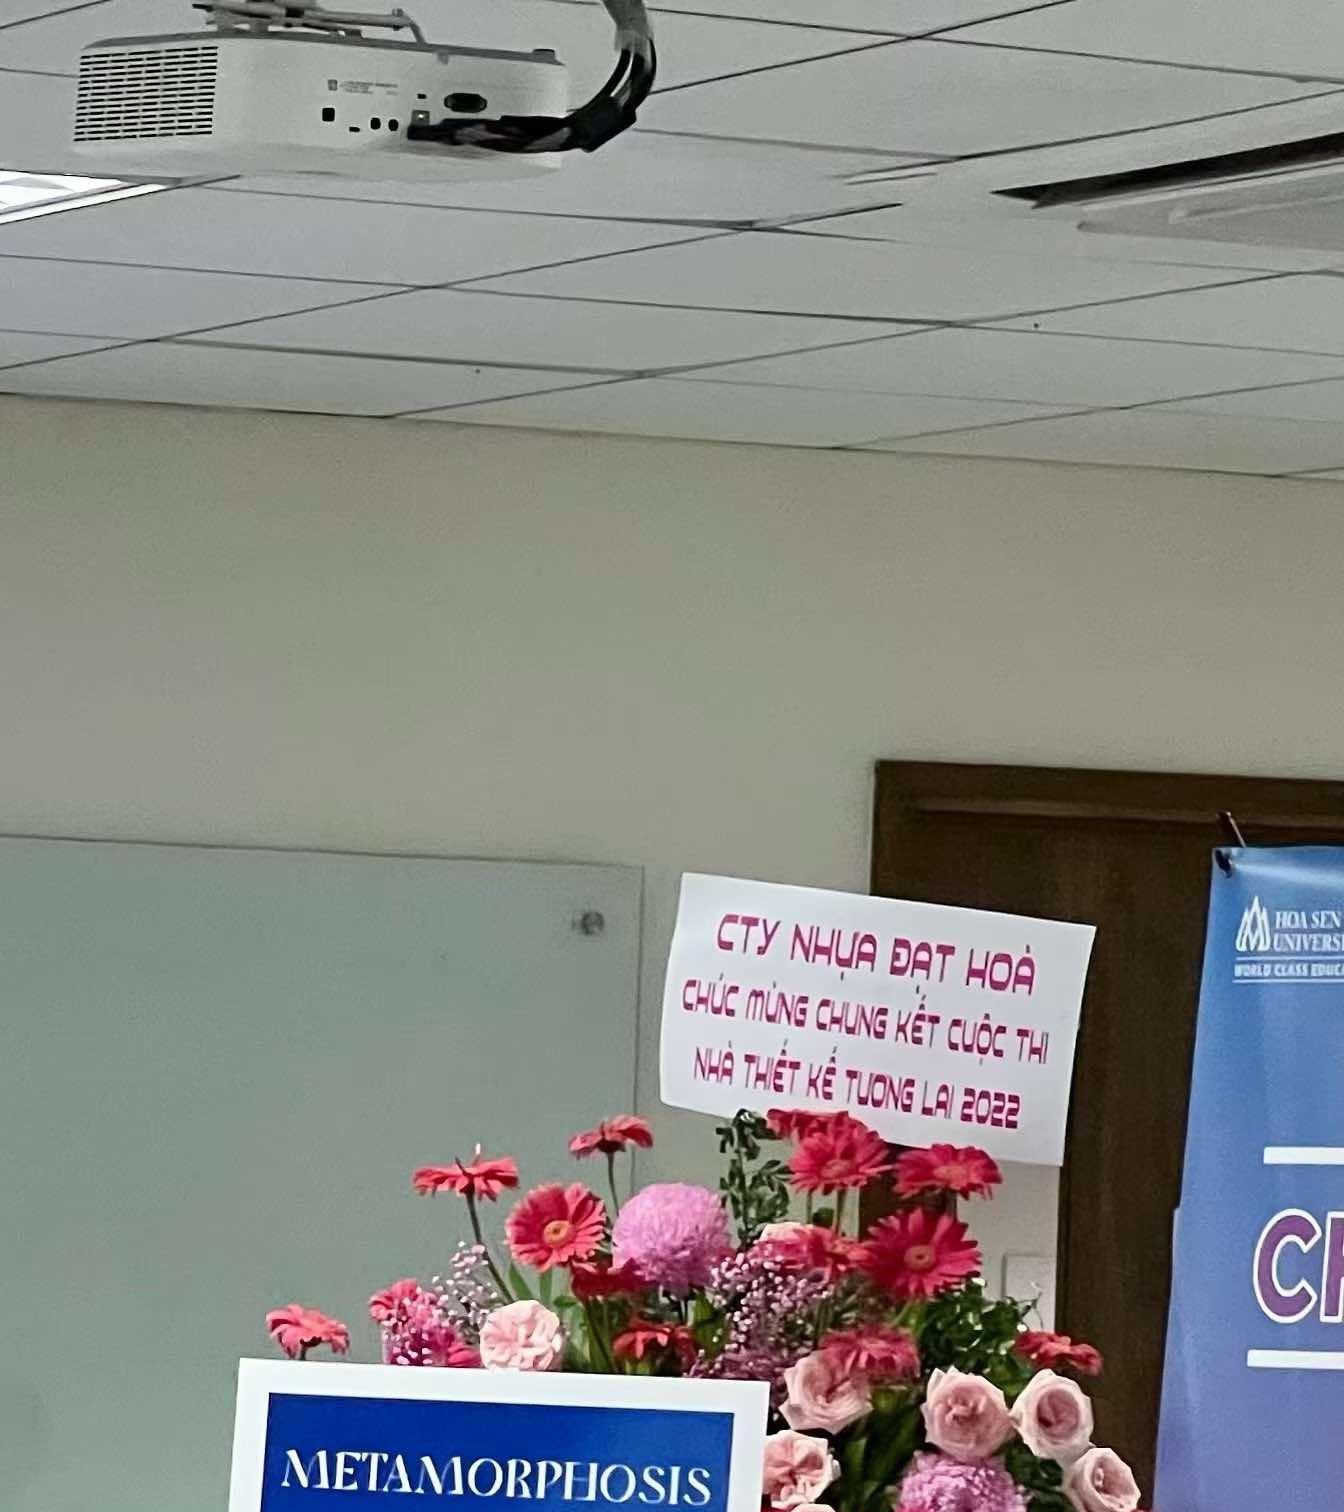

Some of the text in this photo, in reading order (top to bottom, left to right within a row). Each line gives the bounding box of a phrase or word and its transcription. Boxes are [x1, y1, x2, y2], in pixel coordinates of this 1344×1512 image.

[717, 914, 781, 956] CTY
[1275, 911, 1342, 929] HOA SEN
[816, 998, 889, 1040] CHUNG
[1016, 1028, 1049, 1065] THI
[694, 1040, 734, 1086] NHÀ
[921, 1080, 955, 1119] LAI
[960, 1087, 1020, 1129] 2022
[280, 1448, 712, 1506] METAMORPHOSIS
